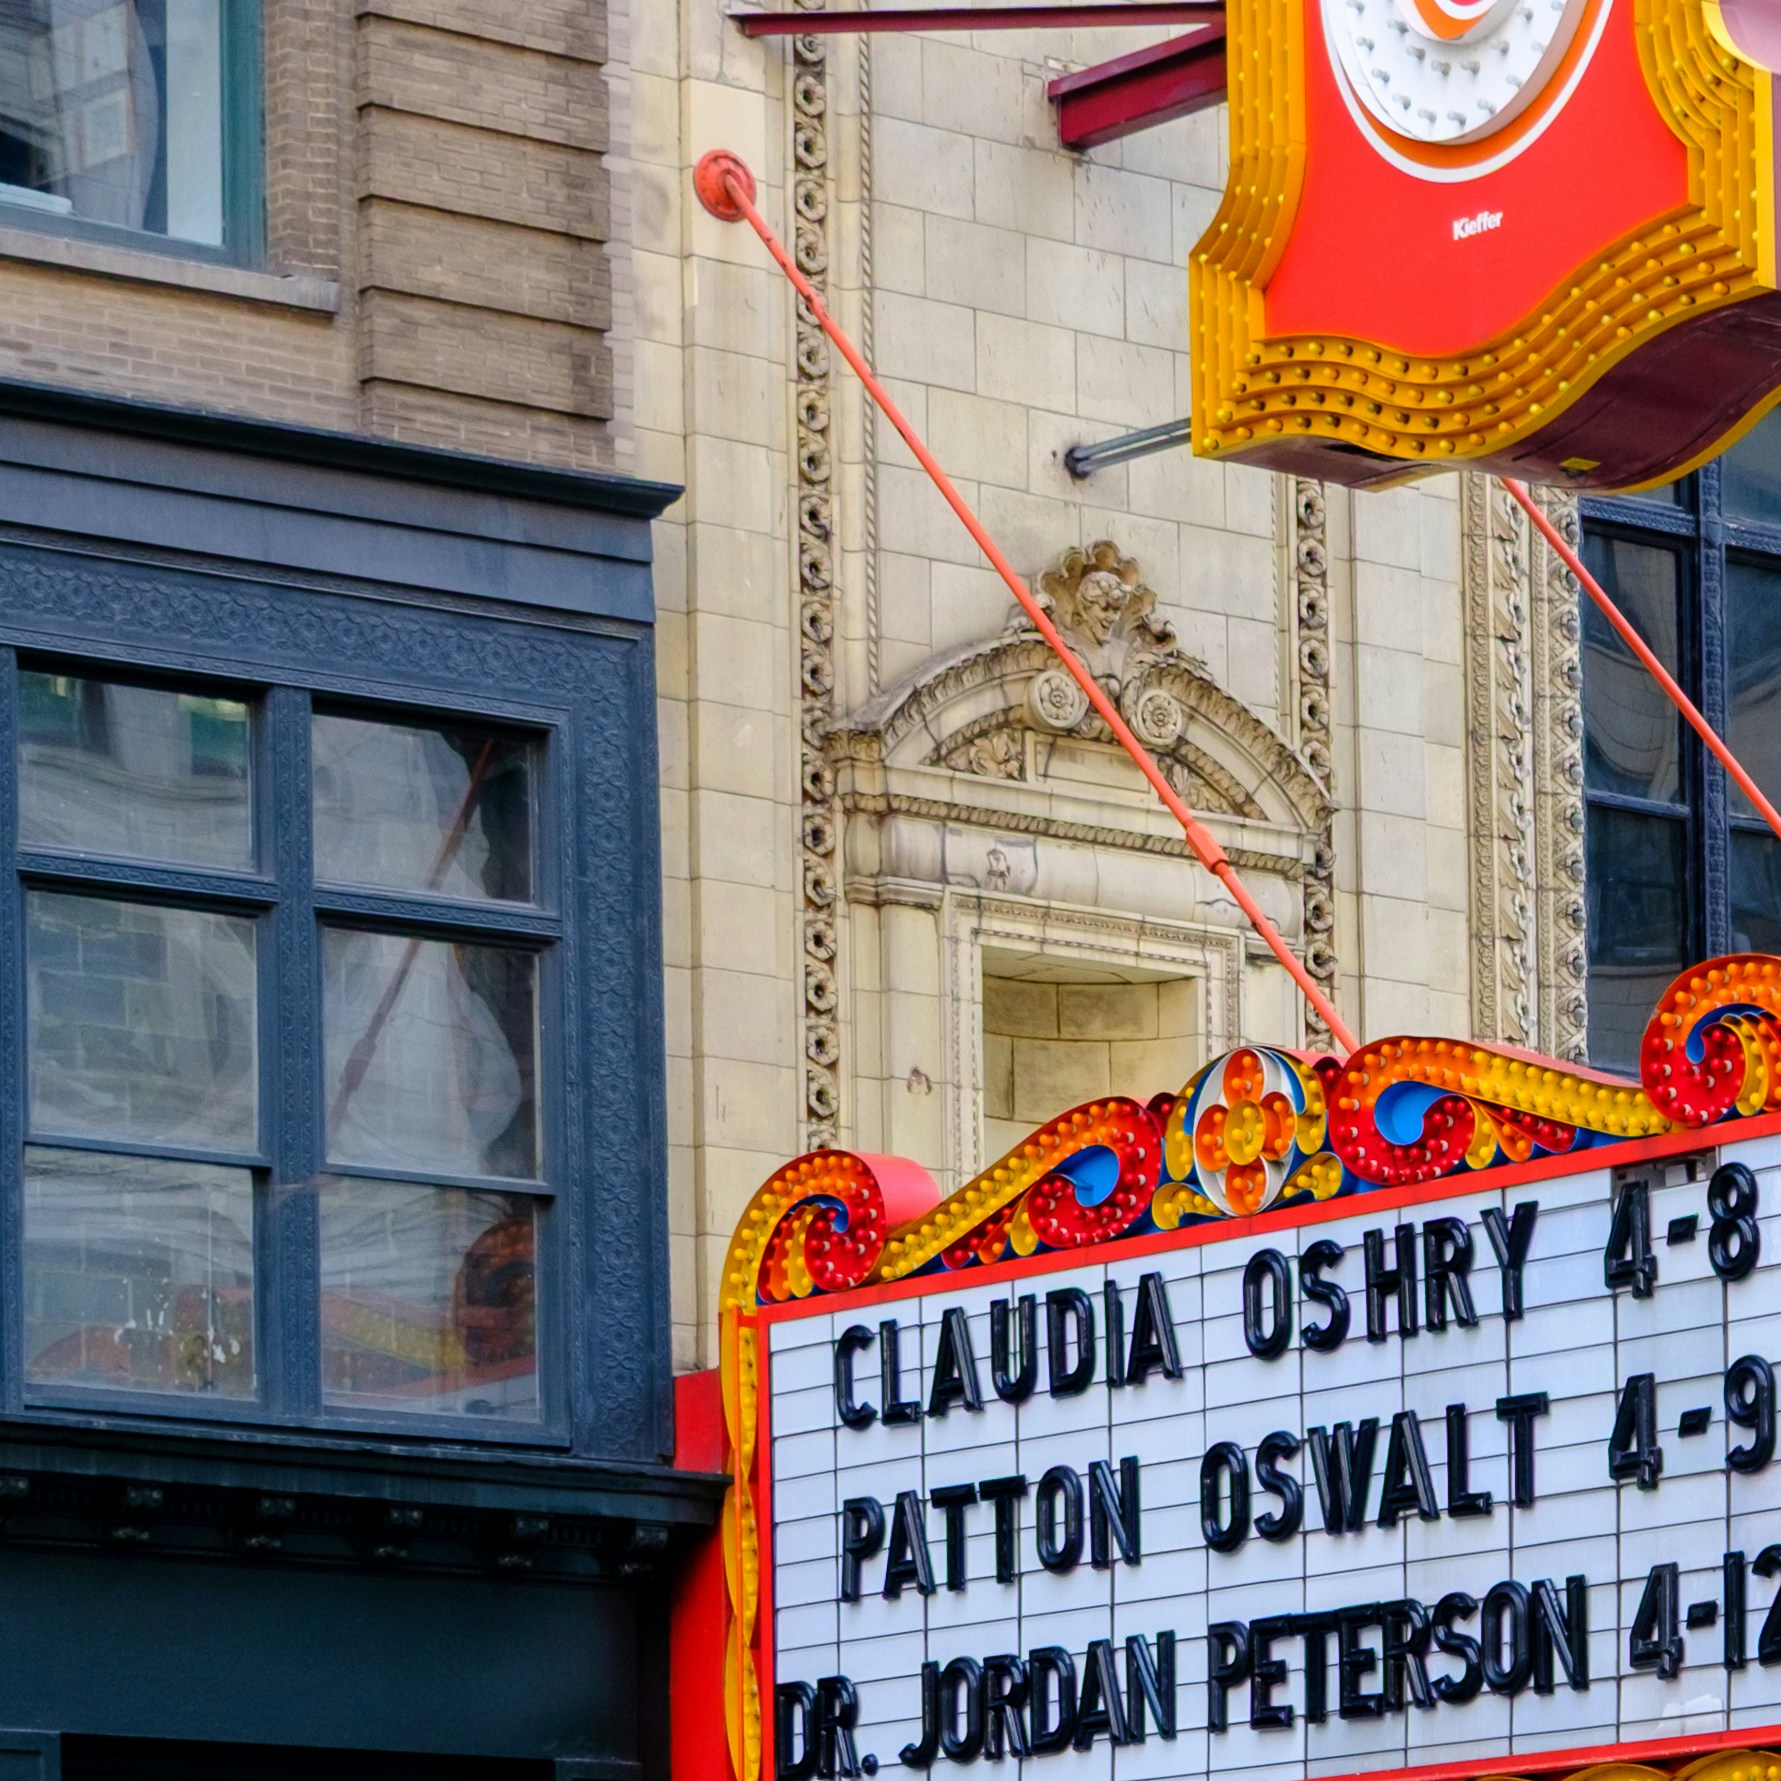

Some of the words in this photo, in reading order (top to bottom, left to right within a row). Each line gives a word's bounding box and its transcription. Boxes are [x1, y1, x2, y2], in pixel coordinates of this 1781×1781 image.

[1453, 211, 1503, 240] Kieffer
[832, 1271, 1184, 1431] CLAUDIA
[1241, 1200, 1538, 1362] OSHRY
[1602, 1160, 1761, 1299] 4-8
[840, 1454, 1141, 1602] PATTON
[1199, 1391, 1549, 1555] OSWALT
[1607, 1355, 1778, 1490] 4-9
[897, 1629, 1178, 1768] JORDAN
[1207, 1573, 1591, 1735] PETERSON
